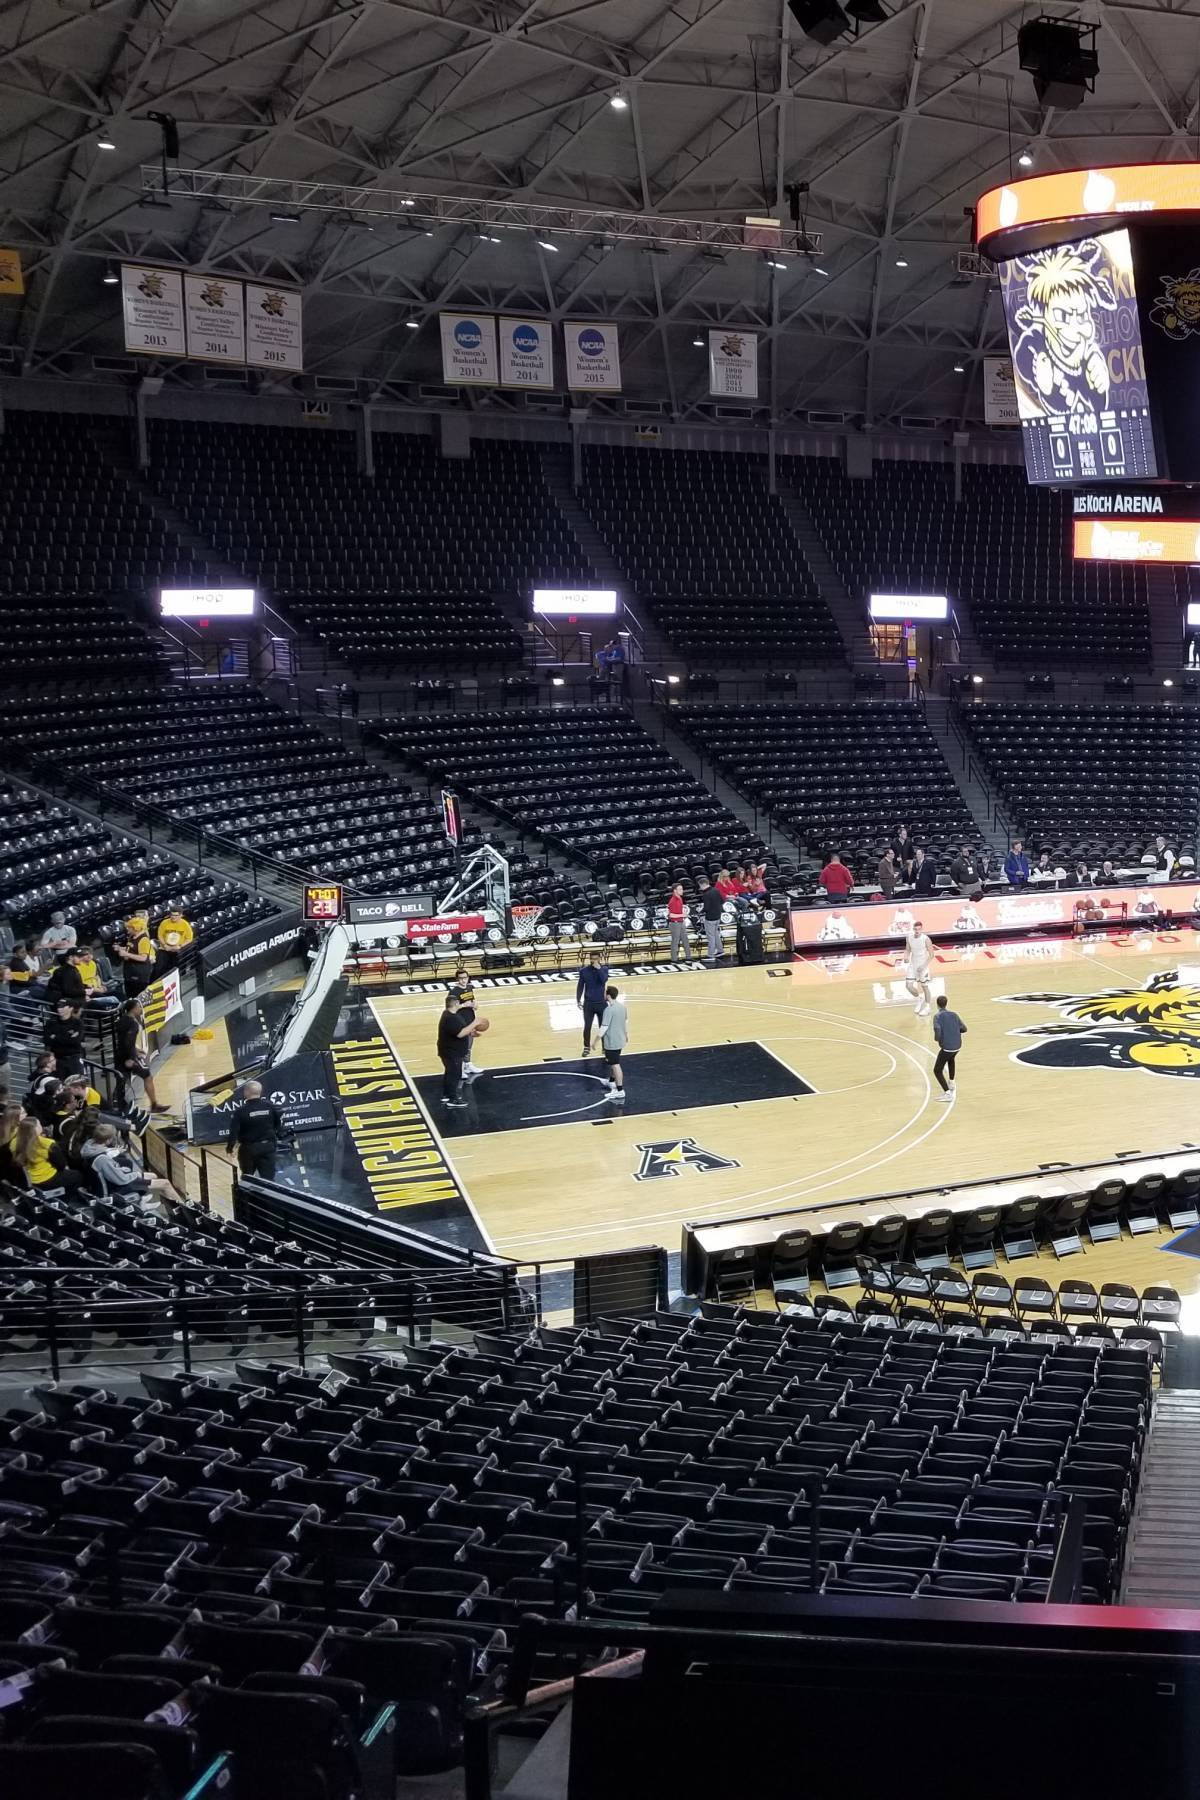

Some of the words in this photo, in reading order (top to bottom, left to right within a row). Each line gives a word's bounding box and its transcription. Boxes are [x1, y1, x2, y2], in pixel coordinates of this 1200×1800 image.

[144, 334, 168, 346] 2013
[457, 334, 481, 342] NCAA
[515, 338, 539, 346] NCAA
[205, 342, 228, 354] 2014
[581, 341, 605, 349] NCAA
[263, 350, 286, 361] 2015
[453, 349, 486, 357] Women's
[511, 352, 543, 361] Women's
[452, 356, 488, 365] Basketball
[510, 360, 544, 369] Basketball
[459, 367, 483, 377] 2013
[576, 364, 611, 372] Basketball
[516, 371, 538, 381] 2014
[584, 374, 605, 383] 2015
[1056, 438, 1066, 459] 0
[1107, 434, 1117, 456] 0
[1087, 495, 1112, 512] KOCH
[1114, 493, 1163, 512] ARENA
[308, 889, 338, 900] 47:07
[312, 901, 332, 916] 23
[356, 907, 382, 916] TACO
[401, 903, 424, 912] BELL
[239, 944, 268, 961] UNDER
[330, 1036, 407, 1096] STATE
[288, 1089, 325, 1104] STAR
[343, 1096, 460, 1210] WICHITA
